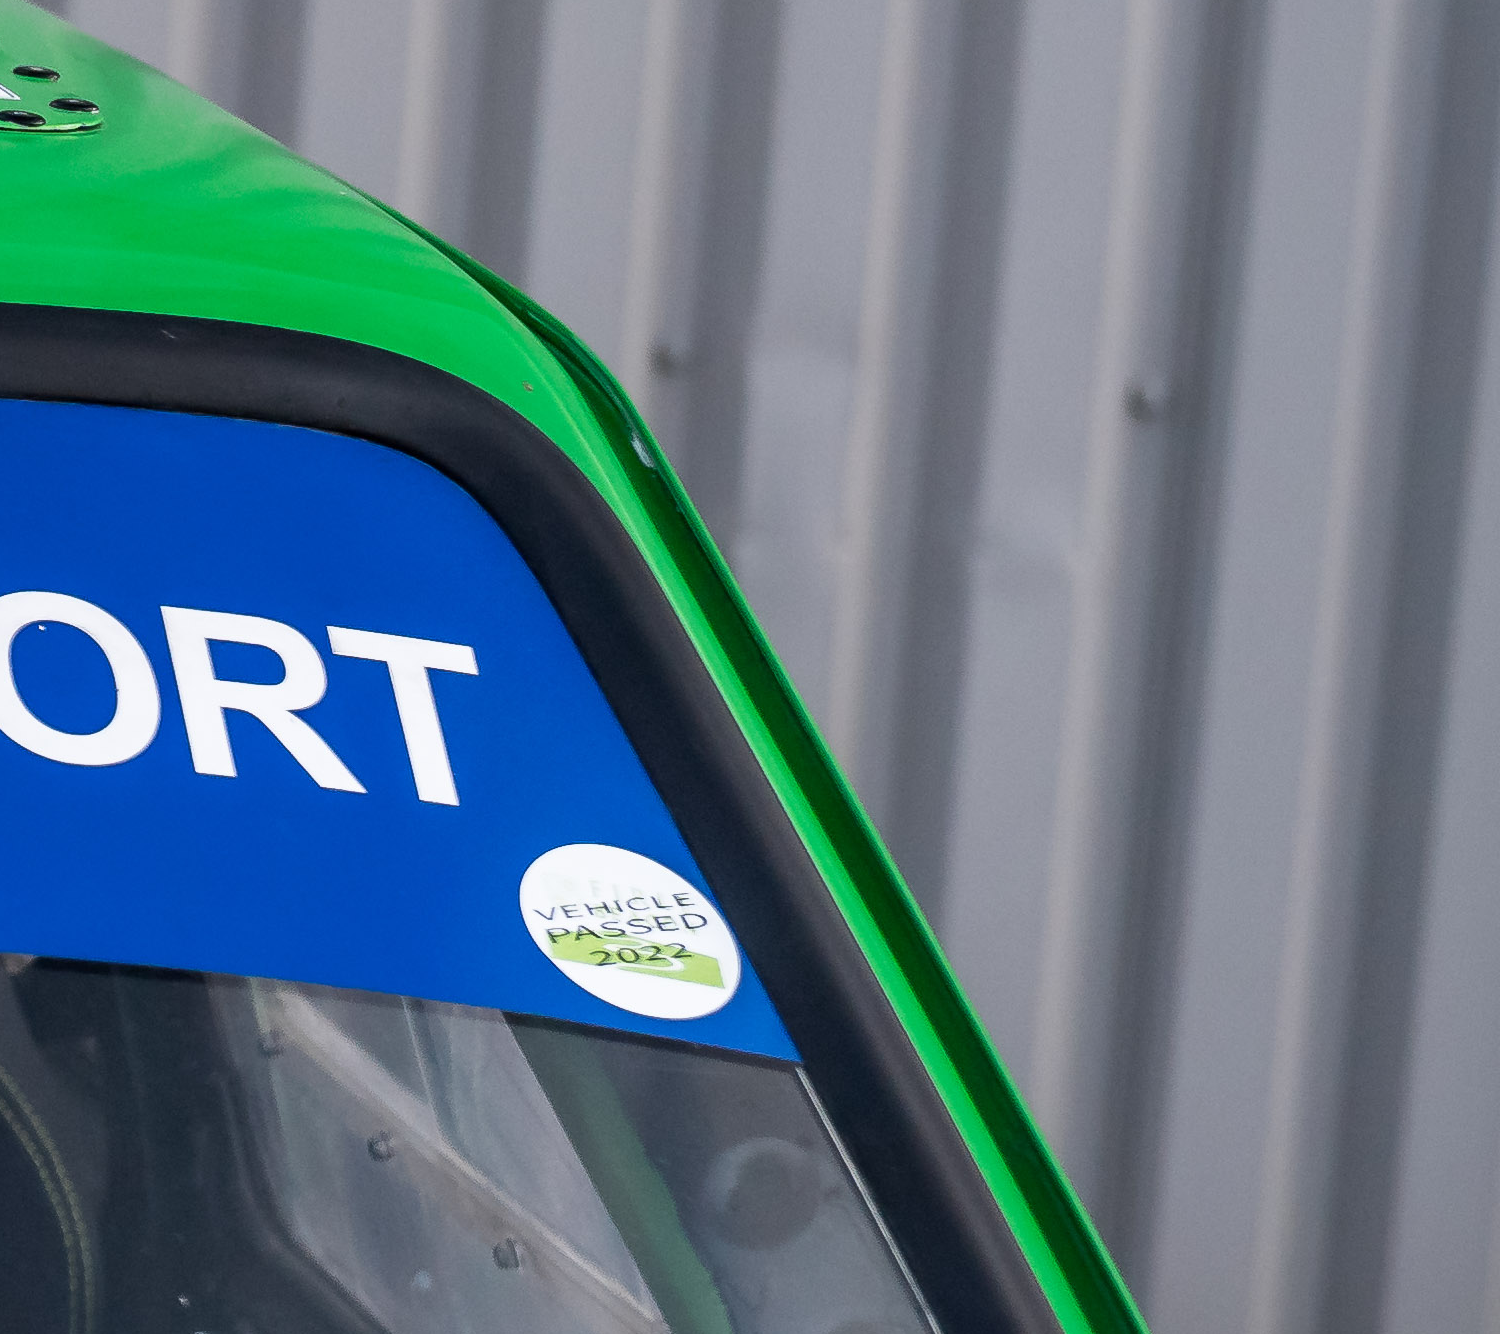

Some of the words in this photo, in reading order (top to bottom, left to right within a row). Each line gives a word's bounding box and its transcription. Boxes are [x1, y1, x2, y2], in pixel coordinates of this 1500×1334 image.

[533, 892, 696, 921] VEHICLE
[546, 913, 708, 944] PASSED
[589, 942, 693, 967] 2022
